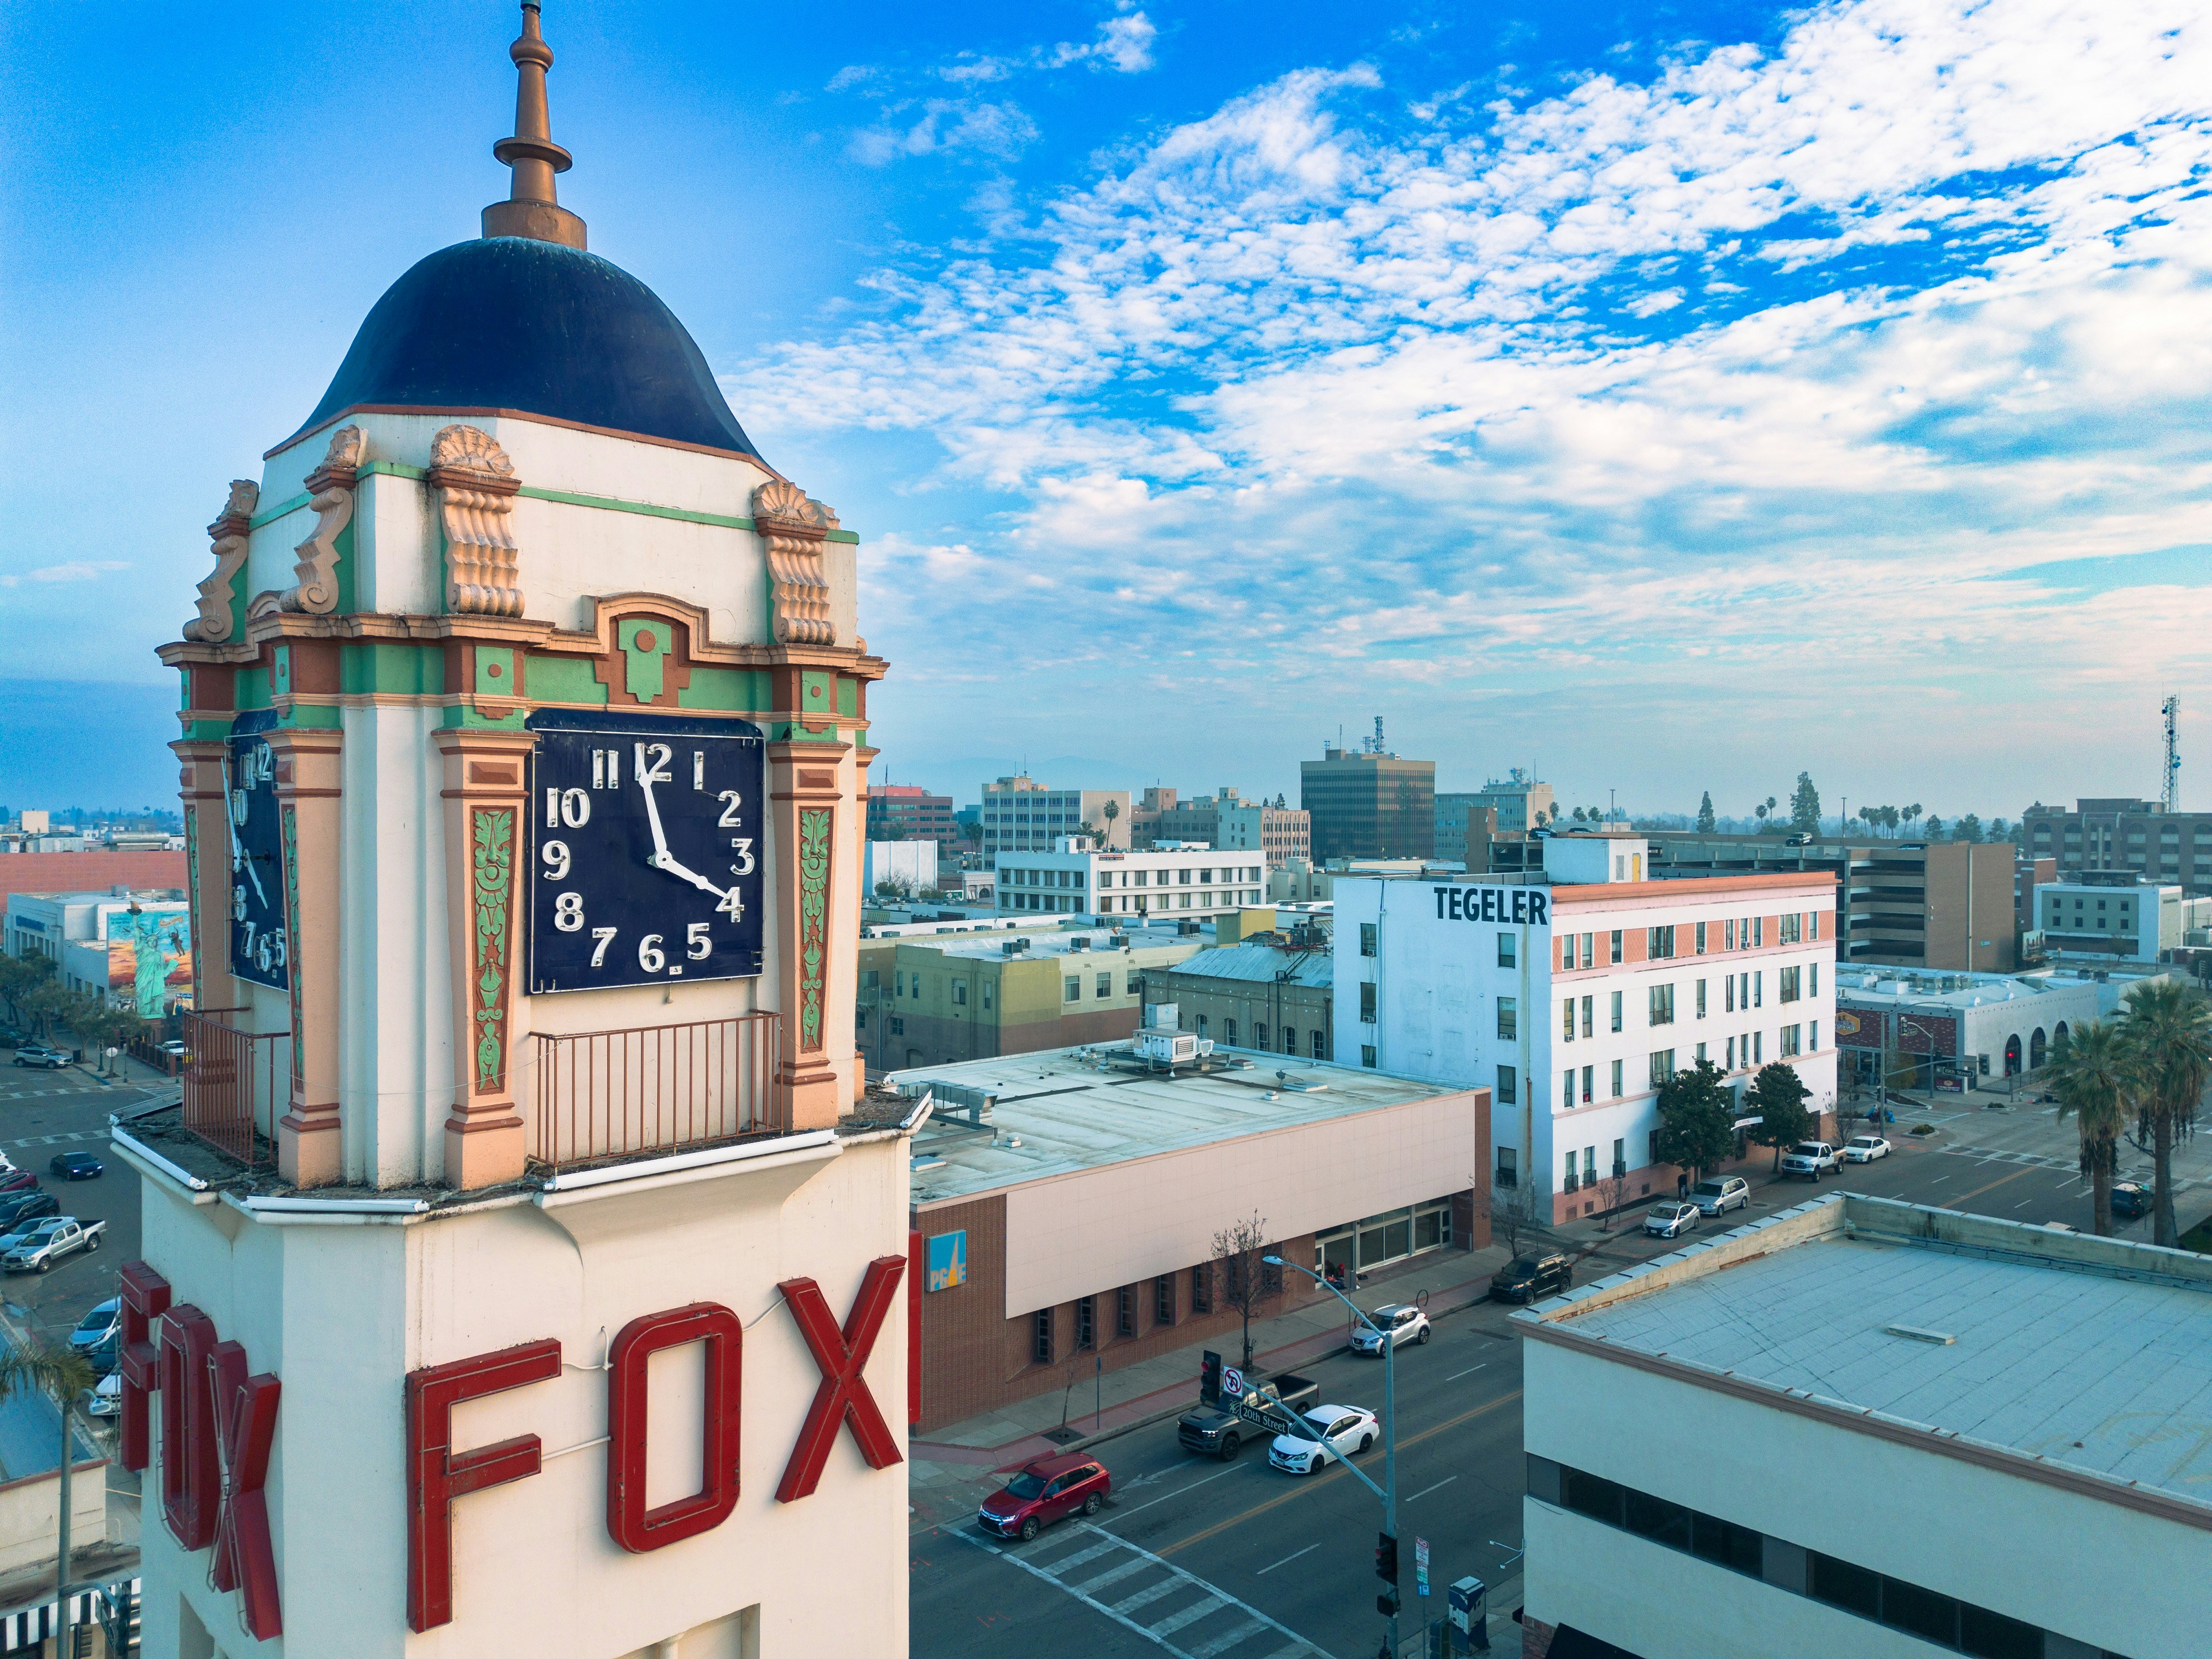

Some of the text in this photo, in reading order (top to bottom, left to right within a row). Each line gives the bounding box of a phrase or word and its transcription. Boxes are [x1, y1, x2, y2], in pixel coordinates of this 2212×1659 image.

[592, 749, 618, 789] 11
[634, 743, 671, 781] 12
[693, 751, 703, 790] 1
[547, 787, 590, 828] 10
[718, 790, 742, 827] 2
[541, 840, 570, 880] 9
[729, 838, 754, 875] 3
[555, 892, 584, 931] 8
[715, 886, 744, 922] 4
[1433, 886, 1548, 925] TEGELER
[591, 927, 617, 967] 7
[639, 934, 665, 973] 6
[687, 923, 712, 959] 5
[930, 1264, 966, 1292] PG&E
[1243, 1407, 1286, 1433] 20th Street
[118, 1259, 282, 1642] FOX
[407, 1255, 907, 1634] FOX
[1417, 1538, 1427, 1547] NO
